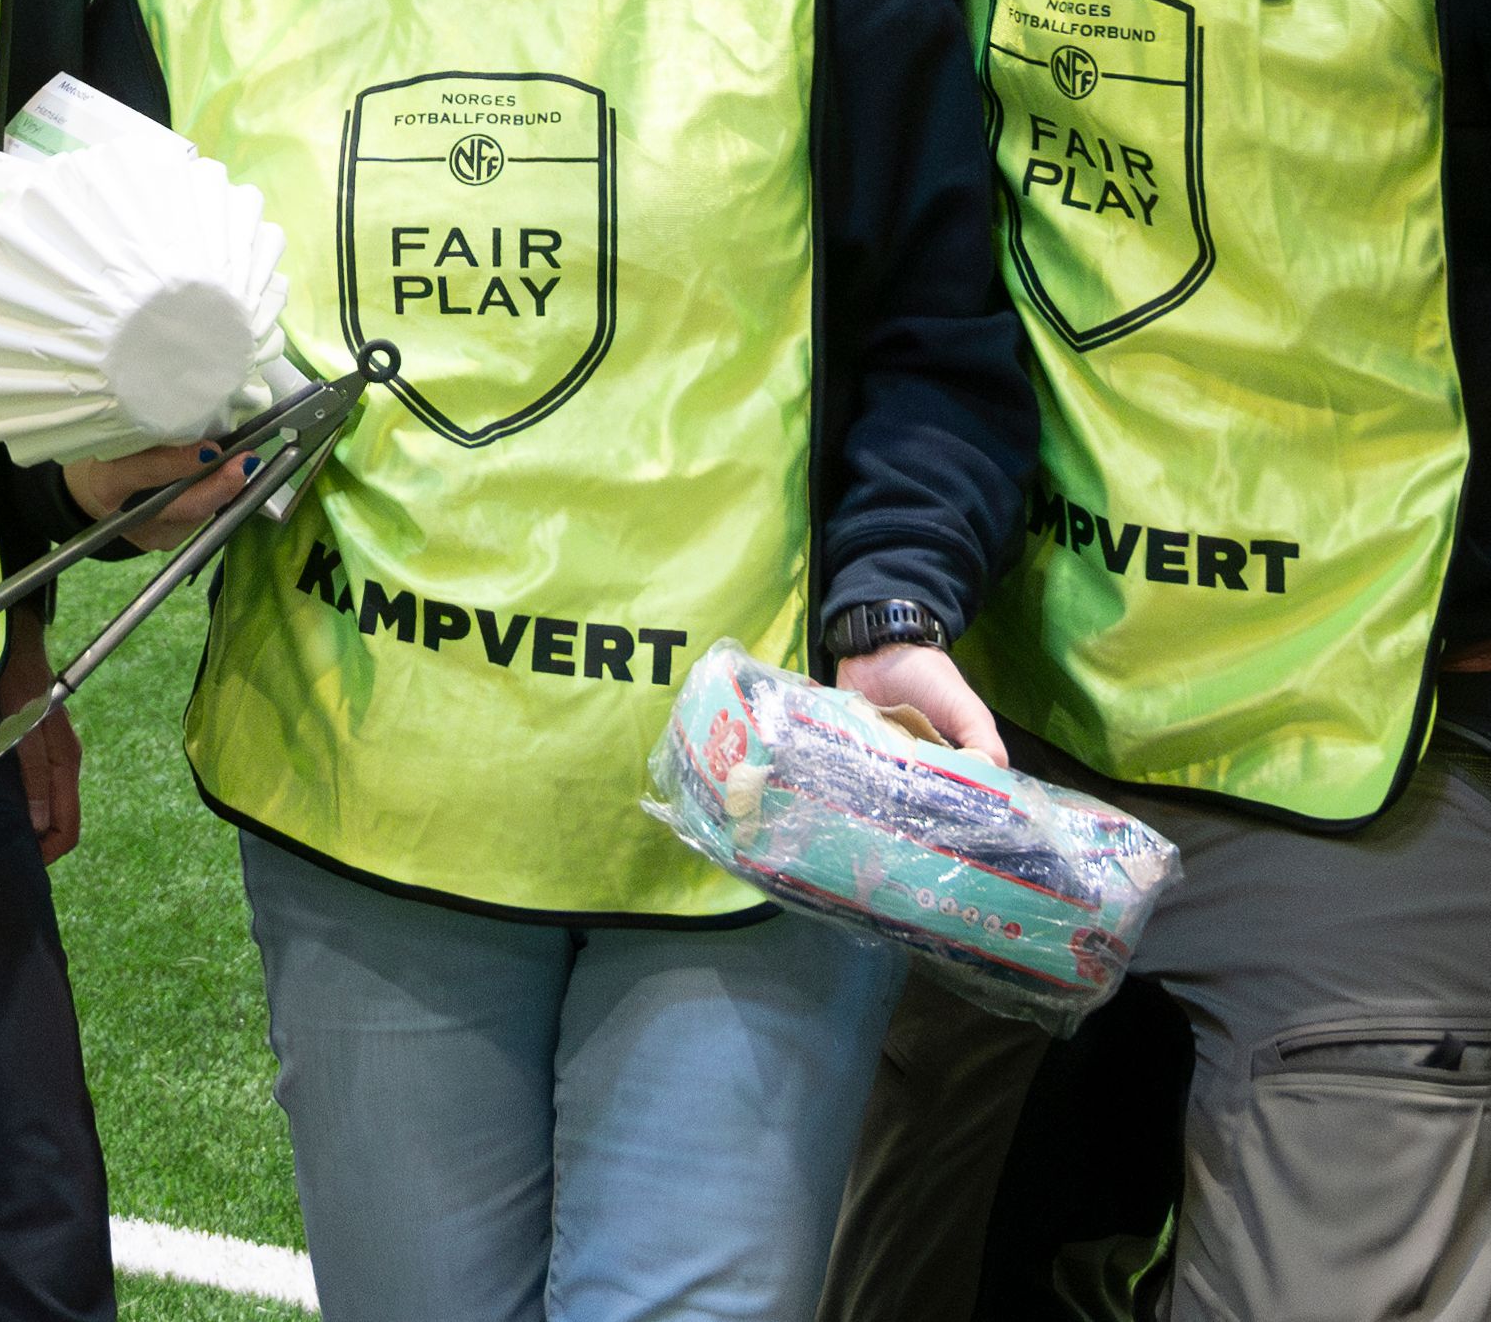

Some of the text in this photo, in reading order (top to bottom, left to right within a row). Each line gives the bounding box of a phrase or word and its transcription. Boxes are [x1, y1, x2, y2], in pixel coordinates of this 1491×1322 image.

[1008, 7, 1156, 43] FOTBALLFORBUND
[394, 111, 562, 127] FOTBALLFORBUND
[441, 93, 516, 107] NORGES
[1029, 113, 1158, 188] FAIR
[1022, 158, 1159, 227] PLAY
[392, 227, 562, 269] FAIR
[393, 275, 561, 317] PLAY
[1028, 488, 1300, 594] MPVERT
